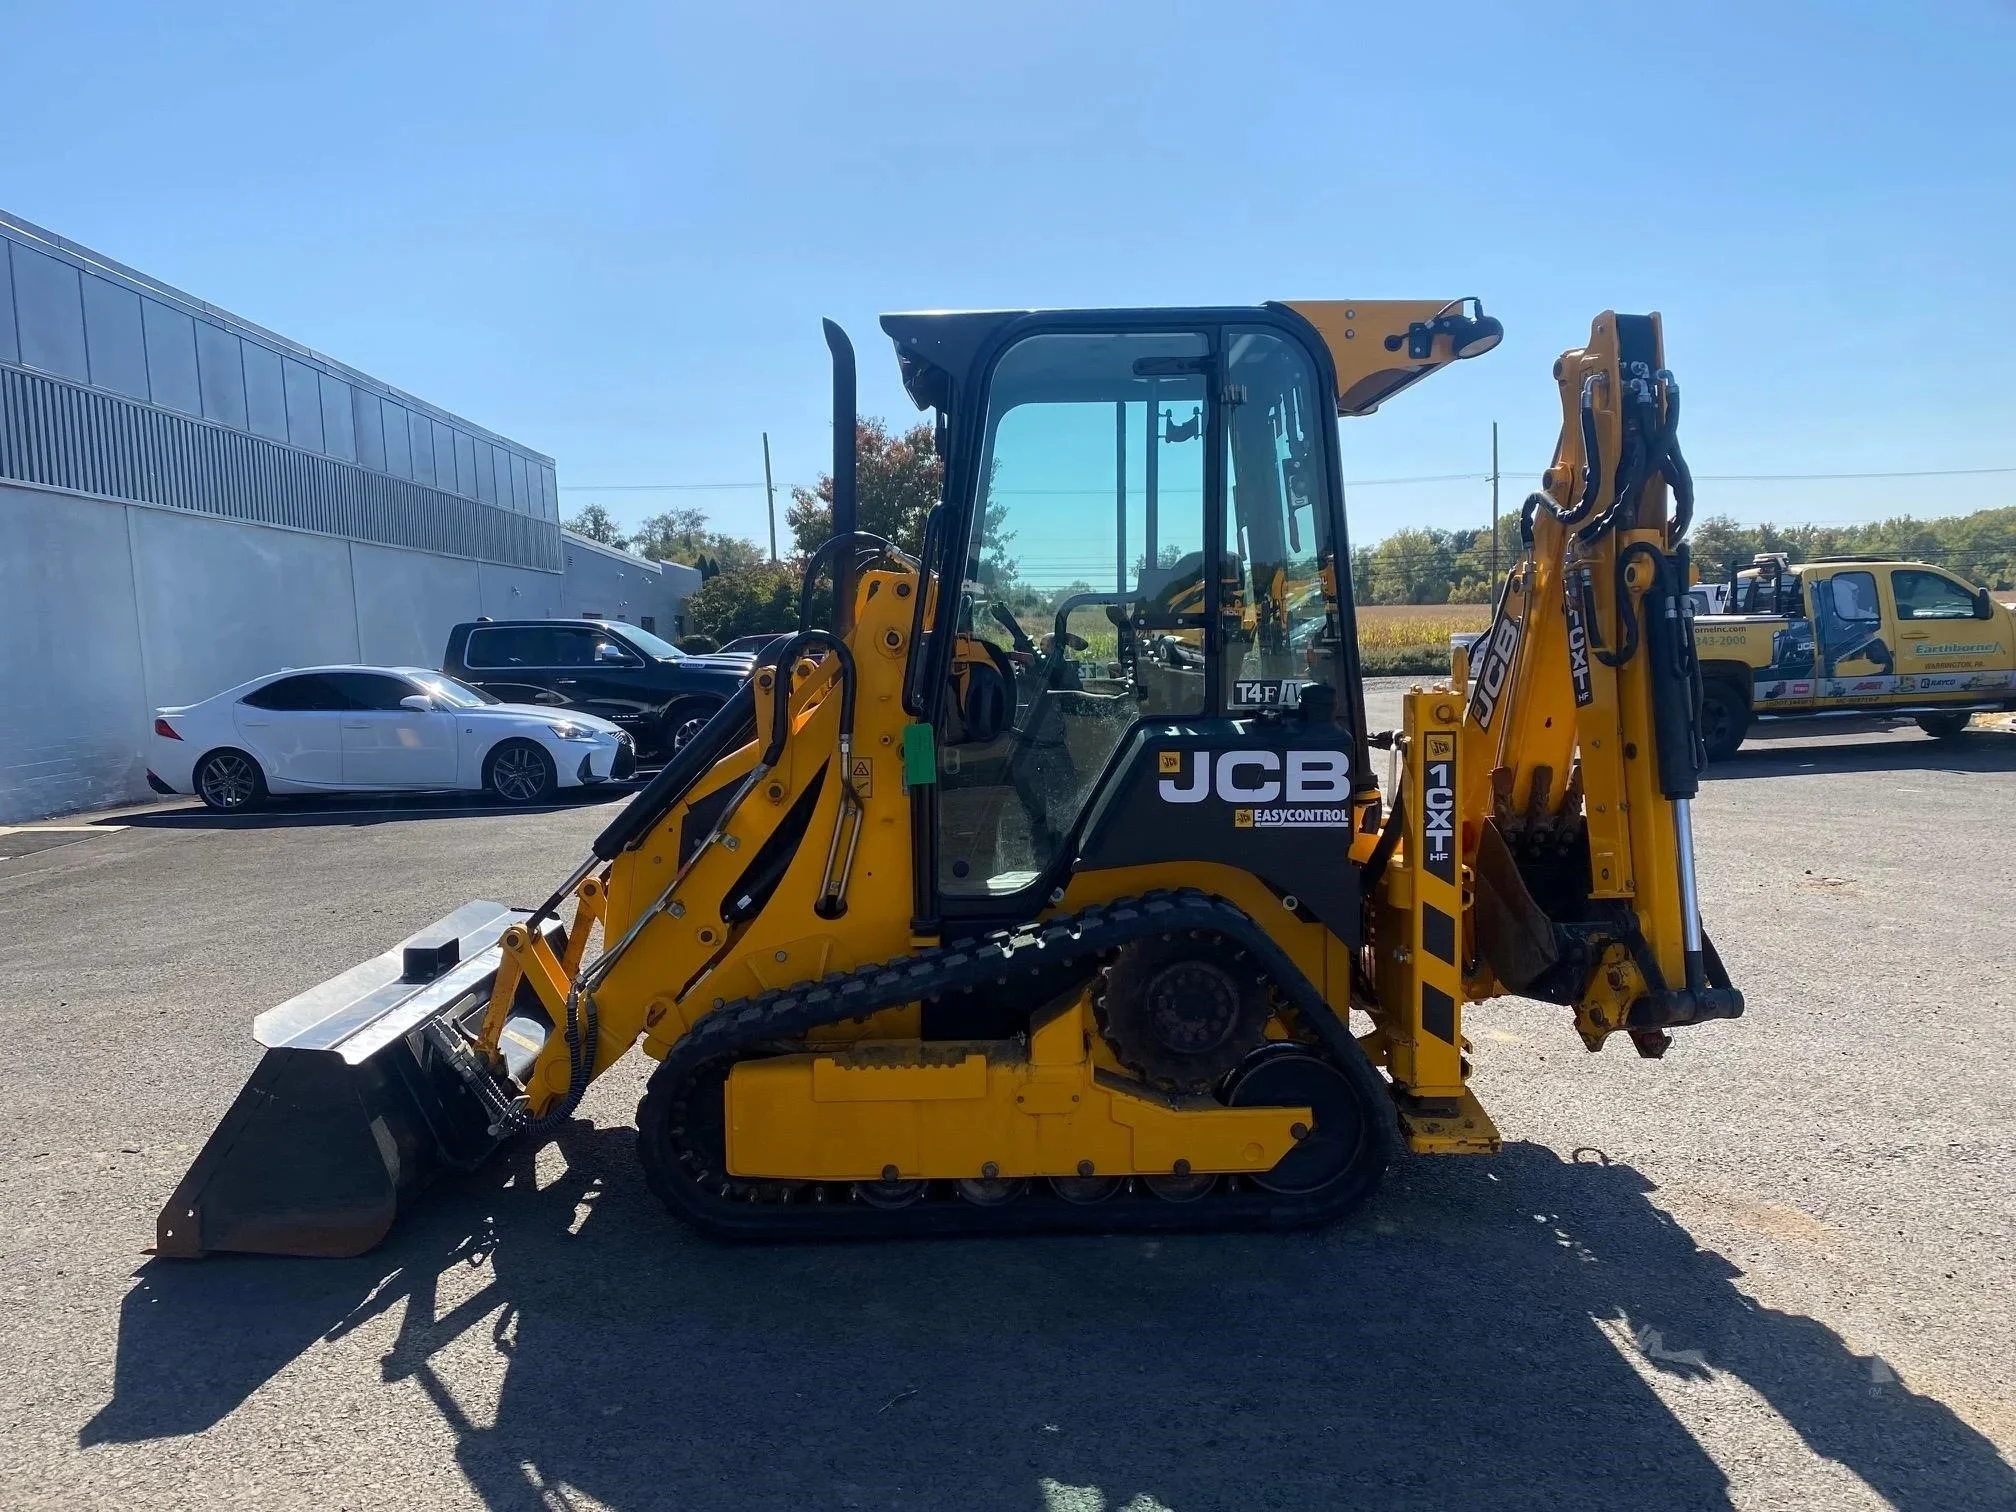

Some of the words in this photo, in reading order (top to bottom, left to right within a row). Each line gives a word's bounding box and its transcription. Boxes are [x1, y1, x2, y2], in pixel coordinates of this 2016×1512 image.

[1478, 618, 1518, 728] JCB
[1915, 642, 1994, 655] Earthborne
[1159, 751, 1350, 803] JCB
[1426, 764, 1453, 852] 1CXT
[1430, 853, 1449, 861] HF
